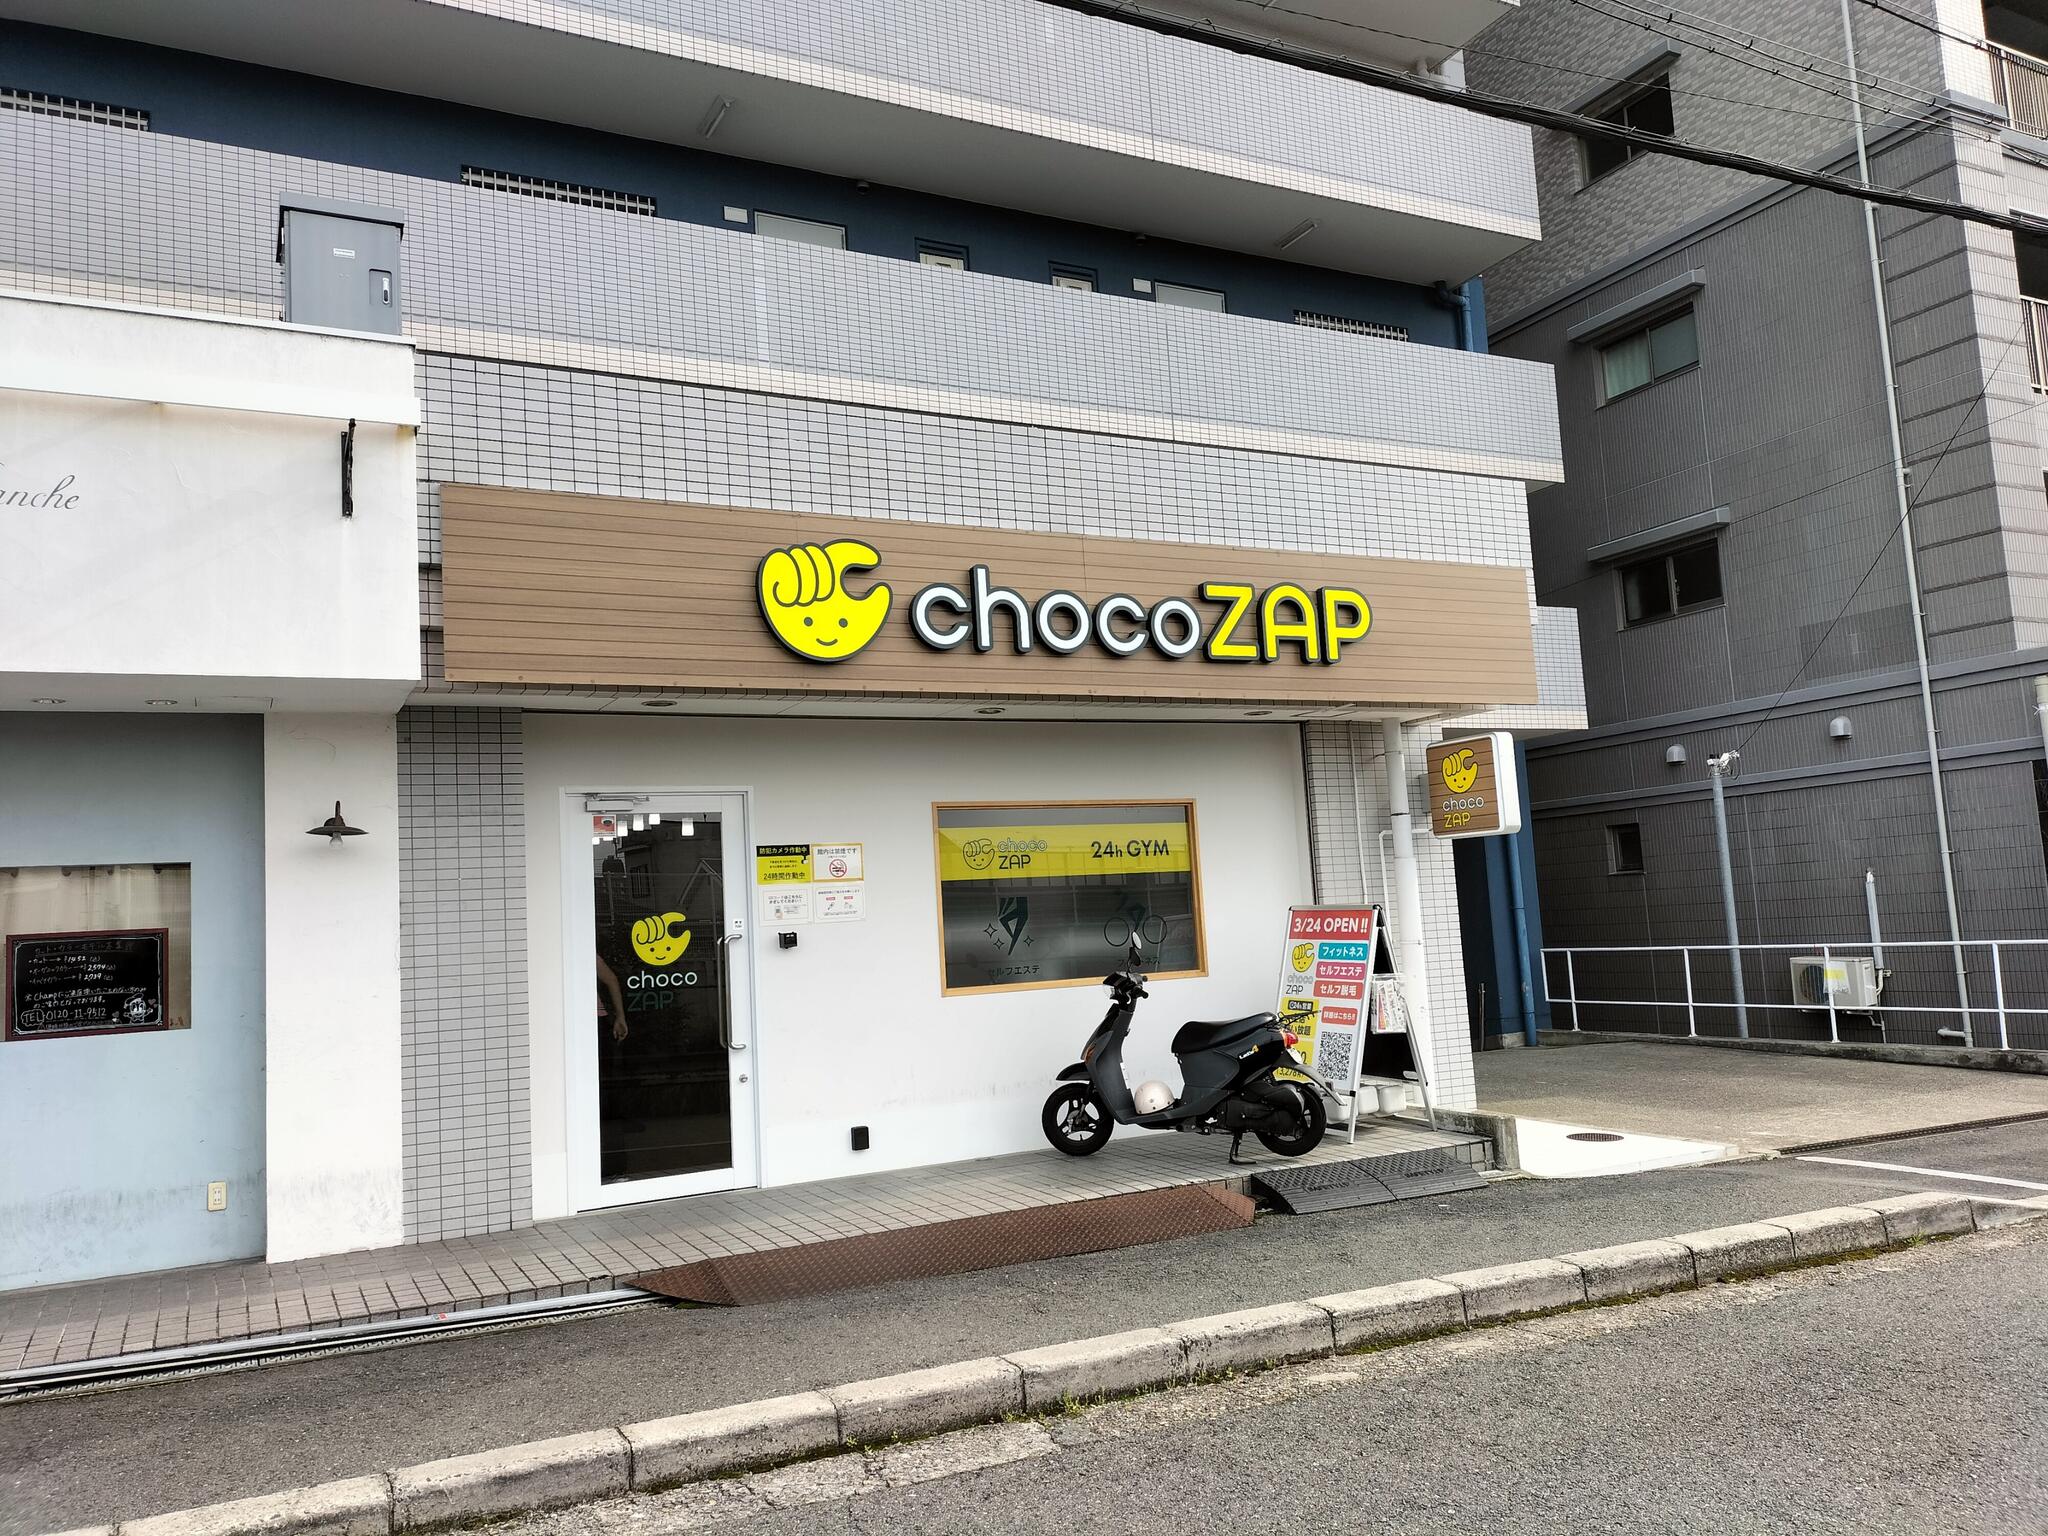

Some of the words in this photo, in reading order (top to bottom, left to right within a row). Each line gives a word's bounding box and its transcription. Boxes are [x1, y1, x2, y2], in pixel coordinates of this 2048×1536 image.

[1442, 796, 1485, 812] choco
[1443, 812, 1472, 829] ZAP
[997, 837, 1048, 853] choco
[1091, 840, 1123, 859] 24h
[1126, 839, 1169, 857] GYM
[998, 854, 1031, 870] ZAP
[1293, 917, 1321, 933] 3/24
[1322, 946, 1364, 957] フィットネス
[1287, 973, 1314, 984] choco
[1319, 964, 1364, 978] セルフエステ
[627, 970, 698, 989] choco
[1286, 984, 1304, 995] ZAP
[1320, 983, 1357, 997] セルフ脱毛
[627, 991, 675, 1013] ZAP
[25, 1011, 42, 1023] TEL
